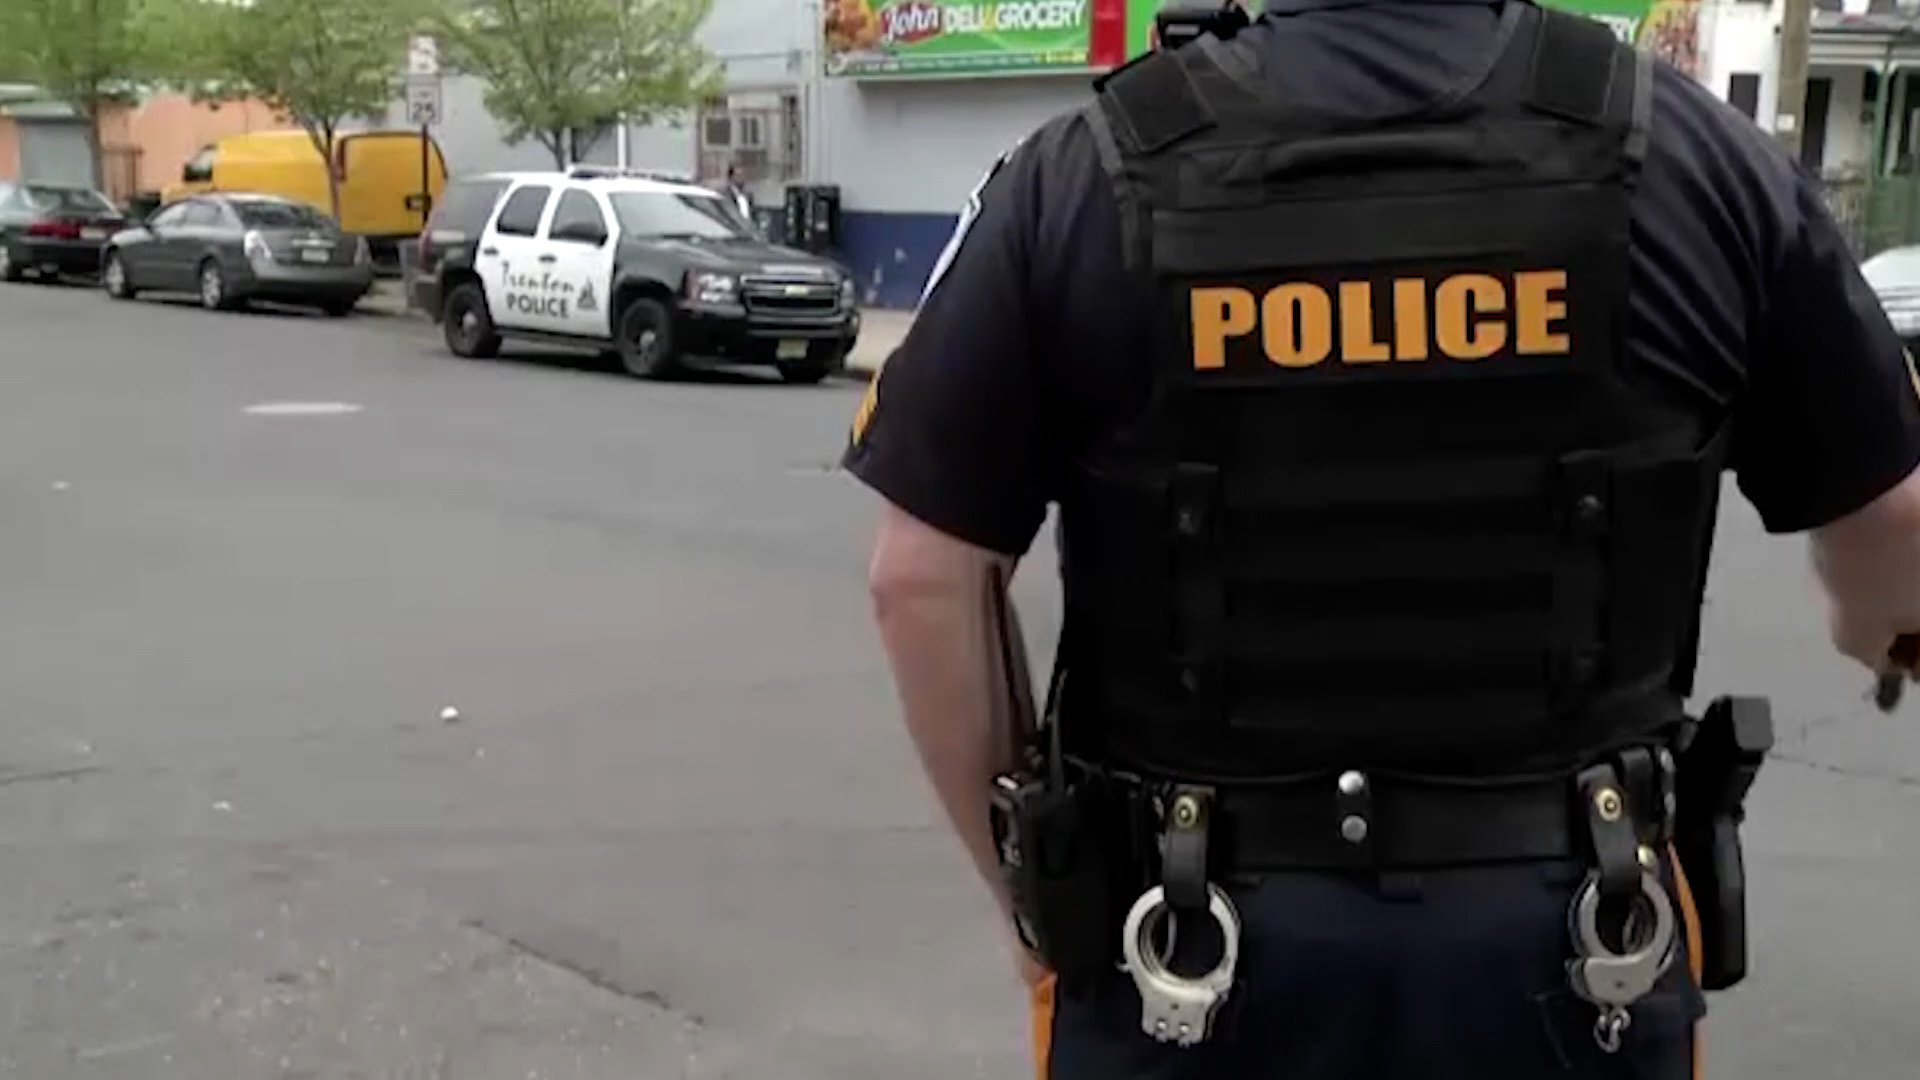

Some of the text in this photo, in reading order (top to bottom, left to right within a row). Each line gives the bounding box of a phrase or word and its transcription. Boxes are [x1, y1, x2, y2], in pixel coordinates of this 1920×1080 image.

[881, 2, 939, 45] John
[995, 0, 1087, 32] GROCERY
[412, 101, 436, 121] 25
[506, 292, 570, 318] POLICE
[1190, 269, 1571, 370] POLICE
